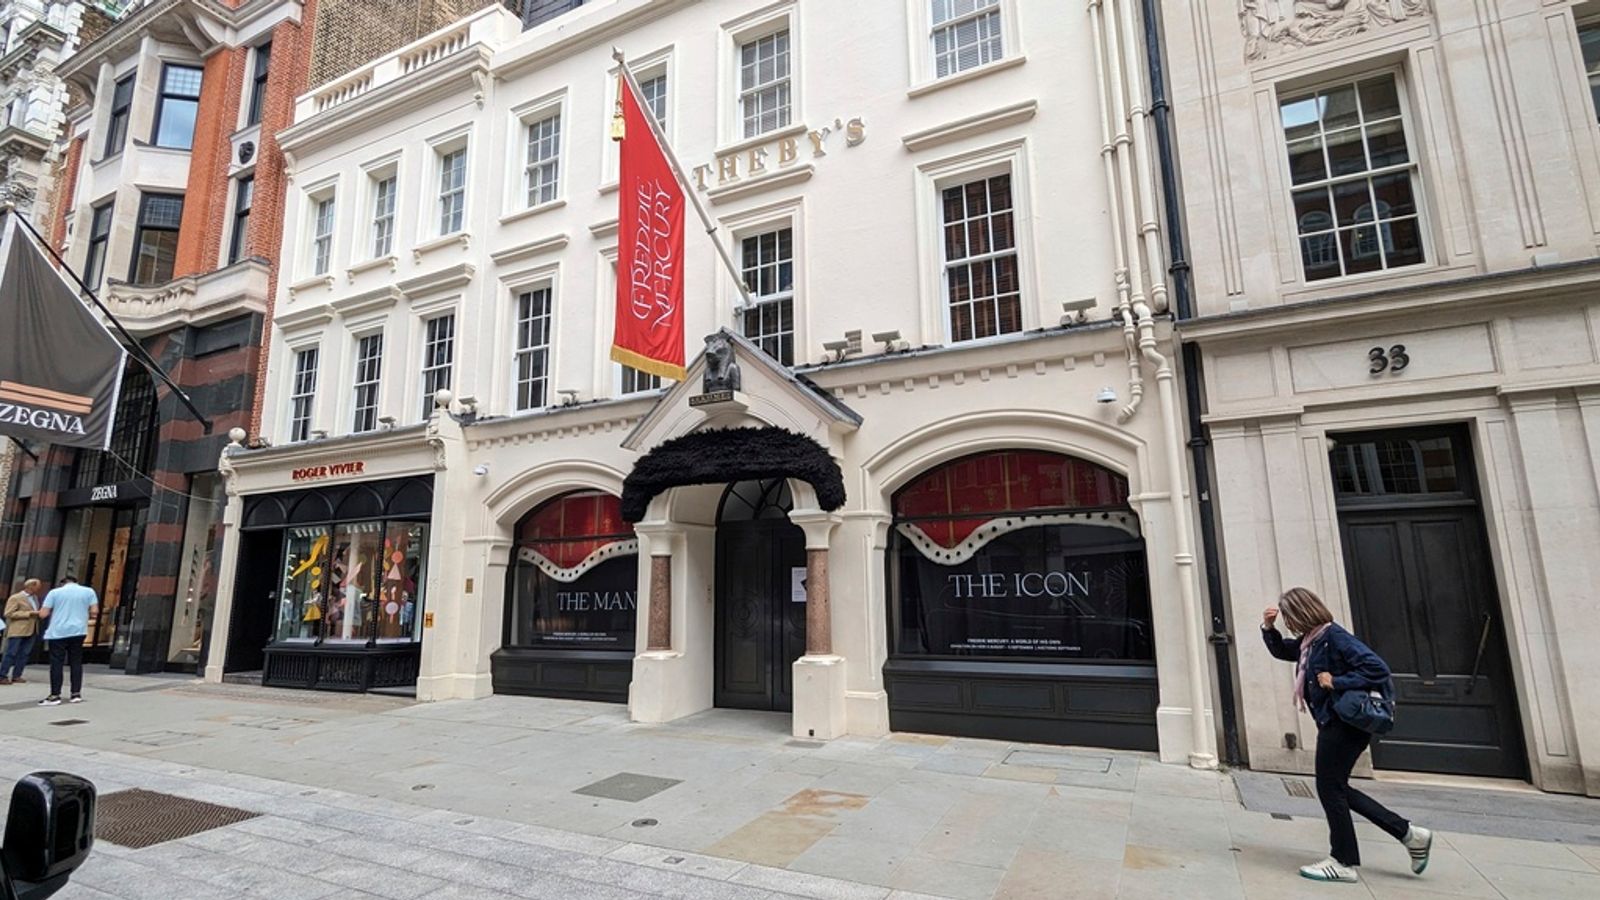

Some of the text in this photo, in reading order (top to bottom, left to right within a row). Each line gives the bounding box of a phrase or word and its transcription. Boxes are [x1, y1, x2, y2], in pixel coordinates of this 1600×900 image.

[692, 116, 866, 192] THEBY'S
[631, 176, 652, 320] FREDDIE
[651, 178, 675, 332] MERCURY
[1368, 344, 1410, 374] 33
[0, 402, 87, 435] ZEGNA
[292, 461, 364, 480] ROGER VIVIER
[91, 485, 118, 501] ZEGNA
[948, 571, 1090, 598] THE ICON
[556, 590, 637, 611] THE MAN
